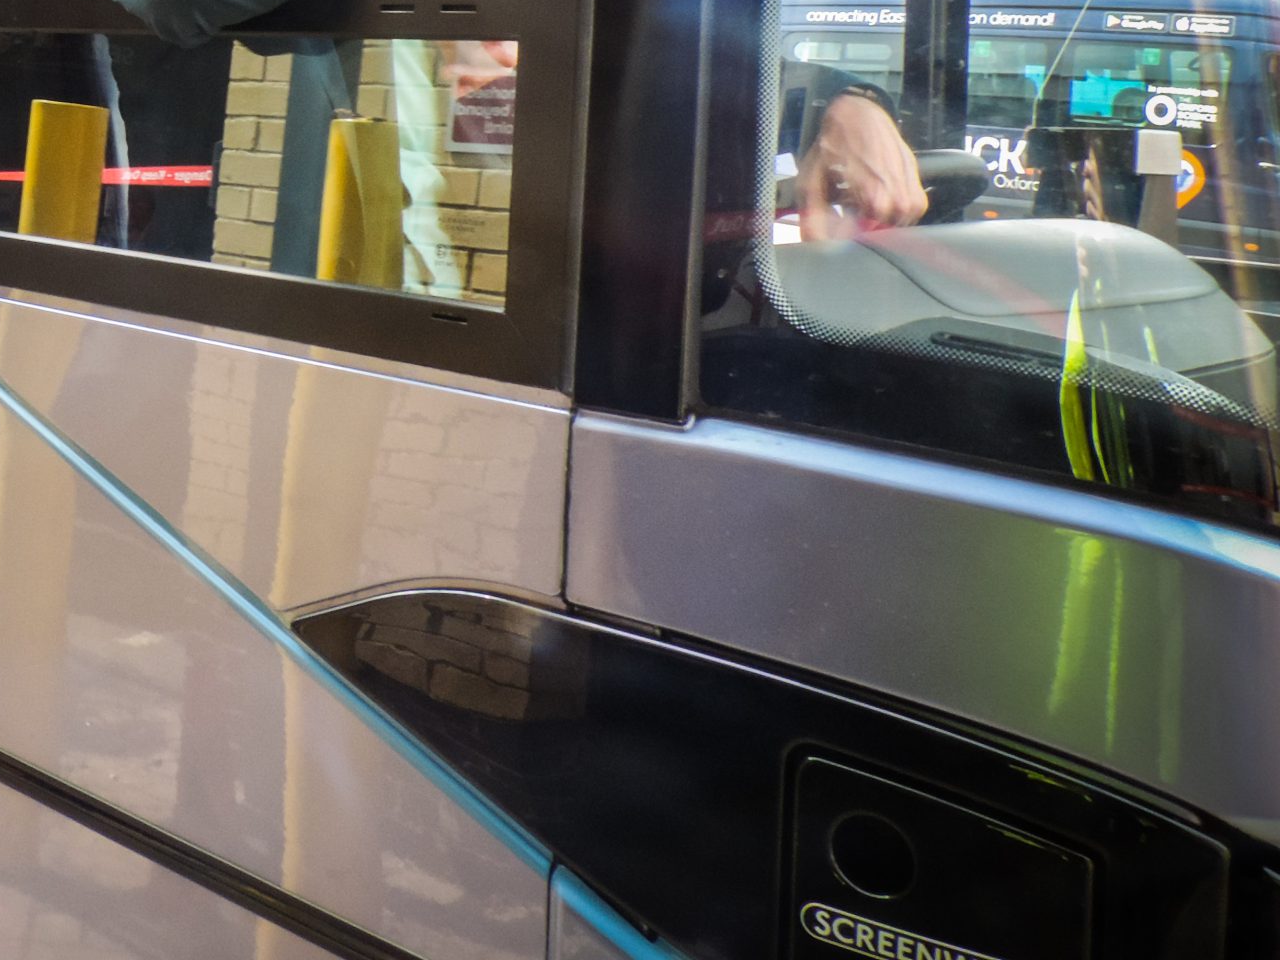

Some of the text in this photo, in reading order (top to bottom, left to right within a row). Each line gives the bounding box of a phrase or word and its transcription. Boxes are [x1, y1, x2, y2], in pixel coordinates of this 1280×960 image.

[806, 9, 878, 26] connecting
[879, 9, 906, 24] Eas
[989, 11, 1055, 27] demand!
